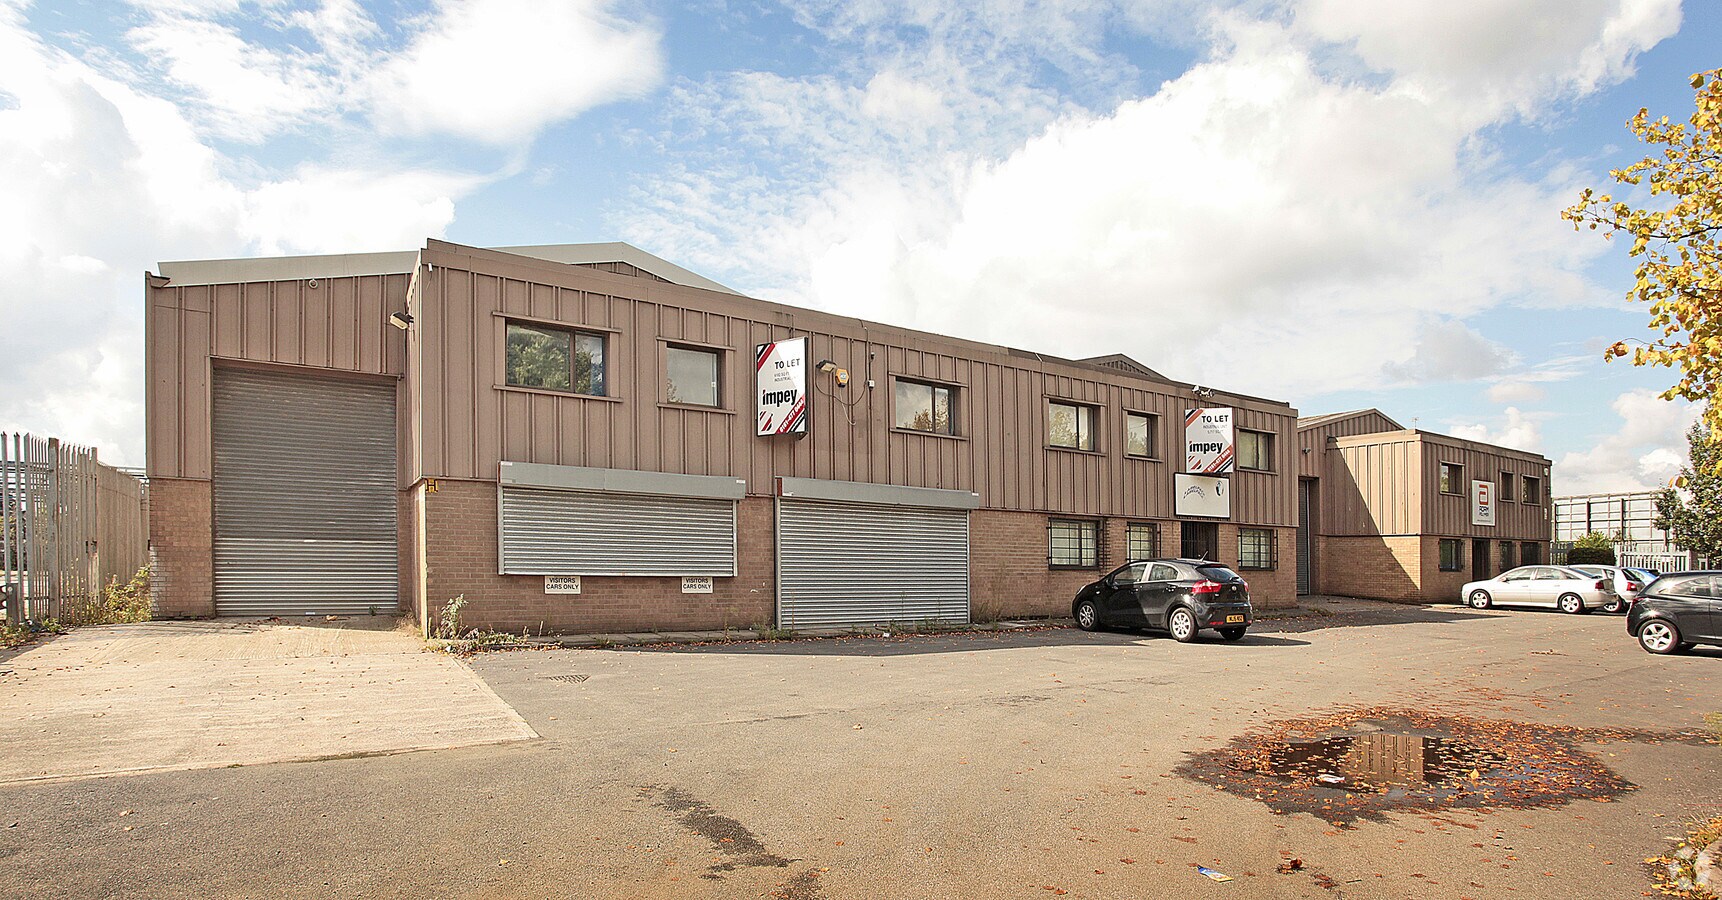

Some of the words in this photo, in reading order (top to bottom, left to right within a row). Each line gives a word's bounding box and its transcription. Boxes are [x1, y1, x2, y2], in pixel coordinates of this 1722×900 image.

[774, 360, 785, 369] TO
[786, 358, 800, 368] LET
[762, 389, 797, 407] impey
[1201, 415, 1212, 423] TO
[1214, 415, 1229, 423] LET
[1189, 441, 1223, 454] impey
